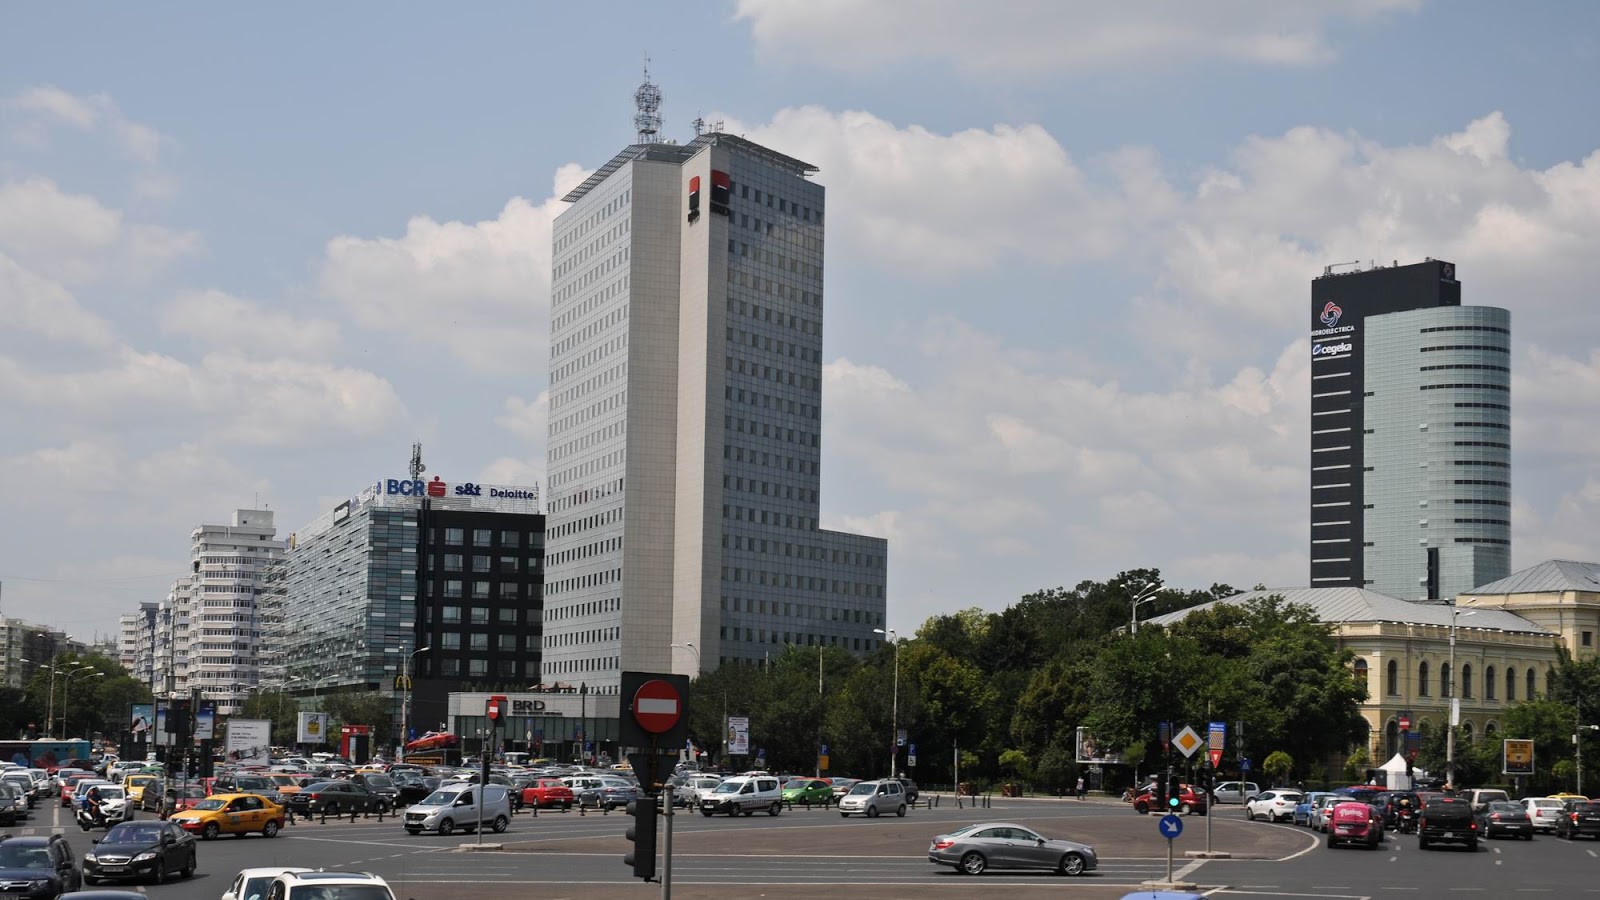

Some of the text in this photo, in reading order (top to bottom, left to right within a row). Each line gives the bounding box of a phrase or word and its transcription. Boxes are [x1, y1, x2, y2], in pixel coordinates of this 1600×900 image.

[1321, 342, 1352, 355] cegeka
[387, 479, 425, 496] BCR
[455, 483, 482, 496] s&t
[512, 700, 546, 711] BRD
